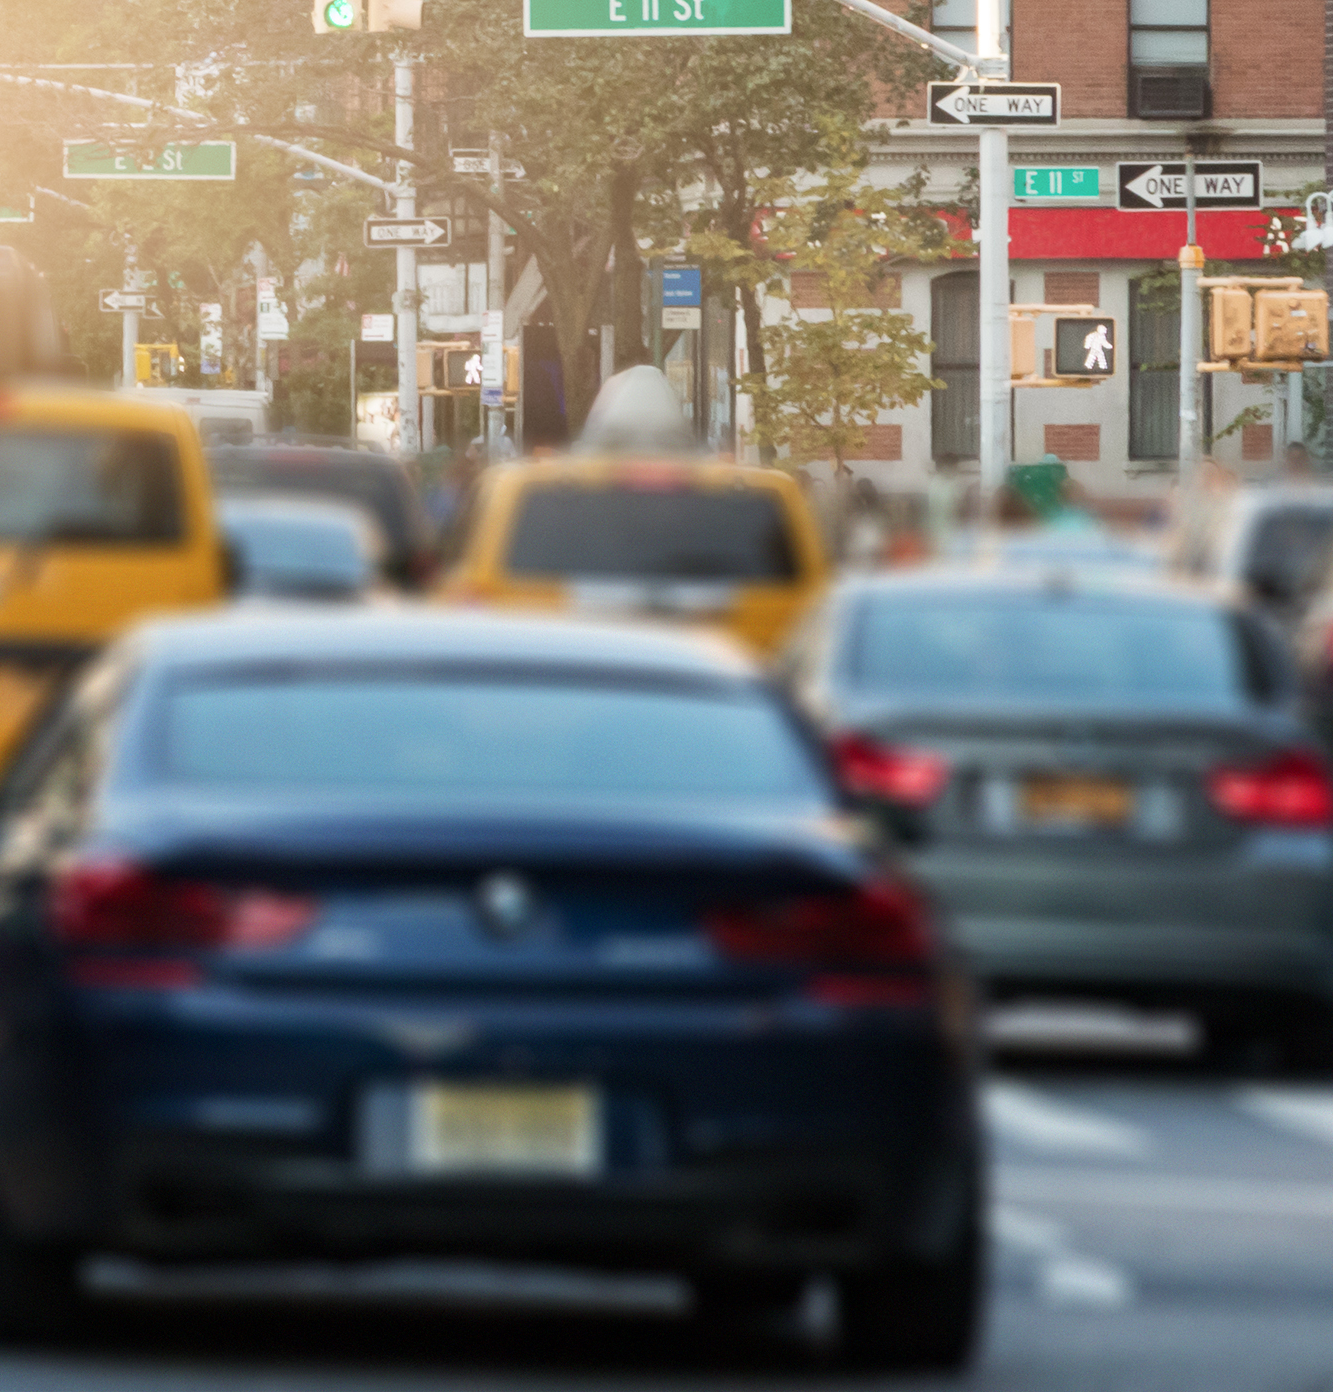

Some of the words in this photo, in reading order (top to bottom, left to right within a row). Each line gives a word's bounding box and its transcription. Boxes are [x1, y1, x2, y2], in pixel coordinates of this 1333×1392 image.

[954, 97, 988, 113] ONE
[1007, 97, 1044, 114] WAY
[163, 149, 183, 170] St
[1025, 171, 1038, 195] E
[1049, 171, 1063, 195] 11
[1072, 171, 1085, 184] ST
[1146, 177, 1183, 195] ONE
[1204, 177, 1245, 194] WAY
[378, 226, 400, 238] ONE
